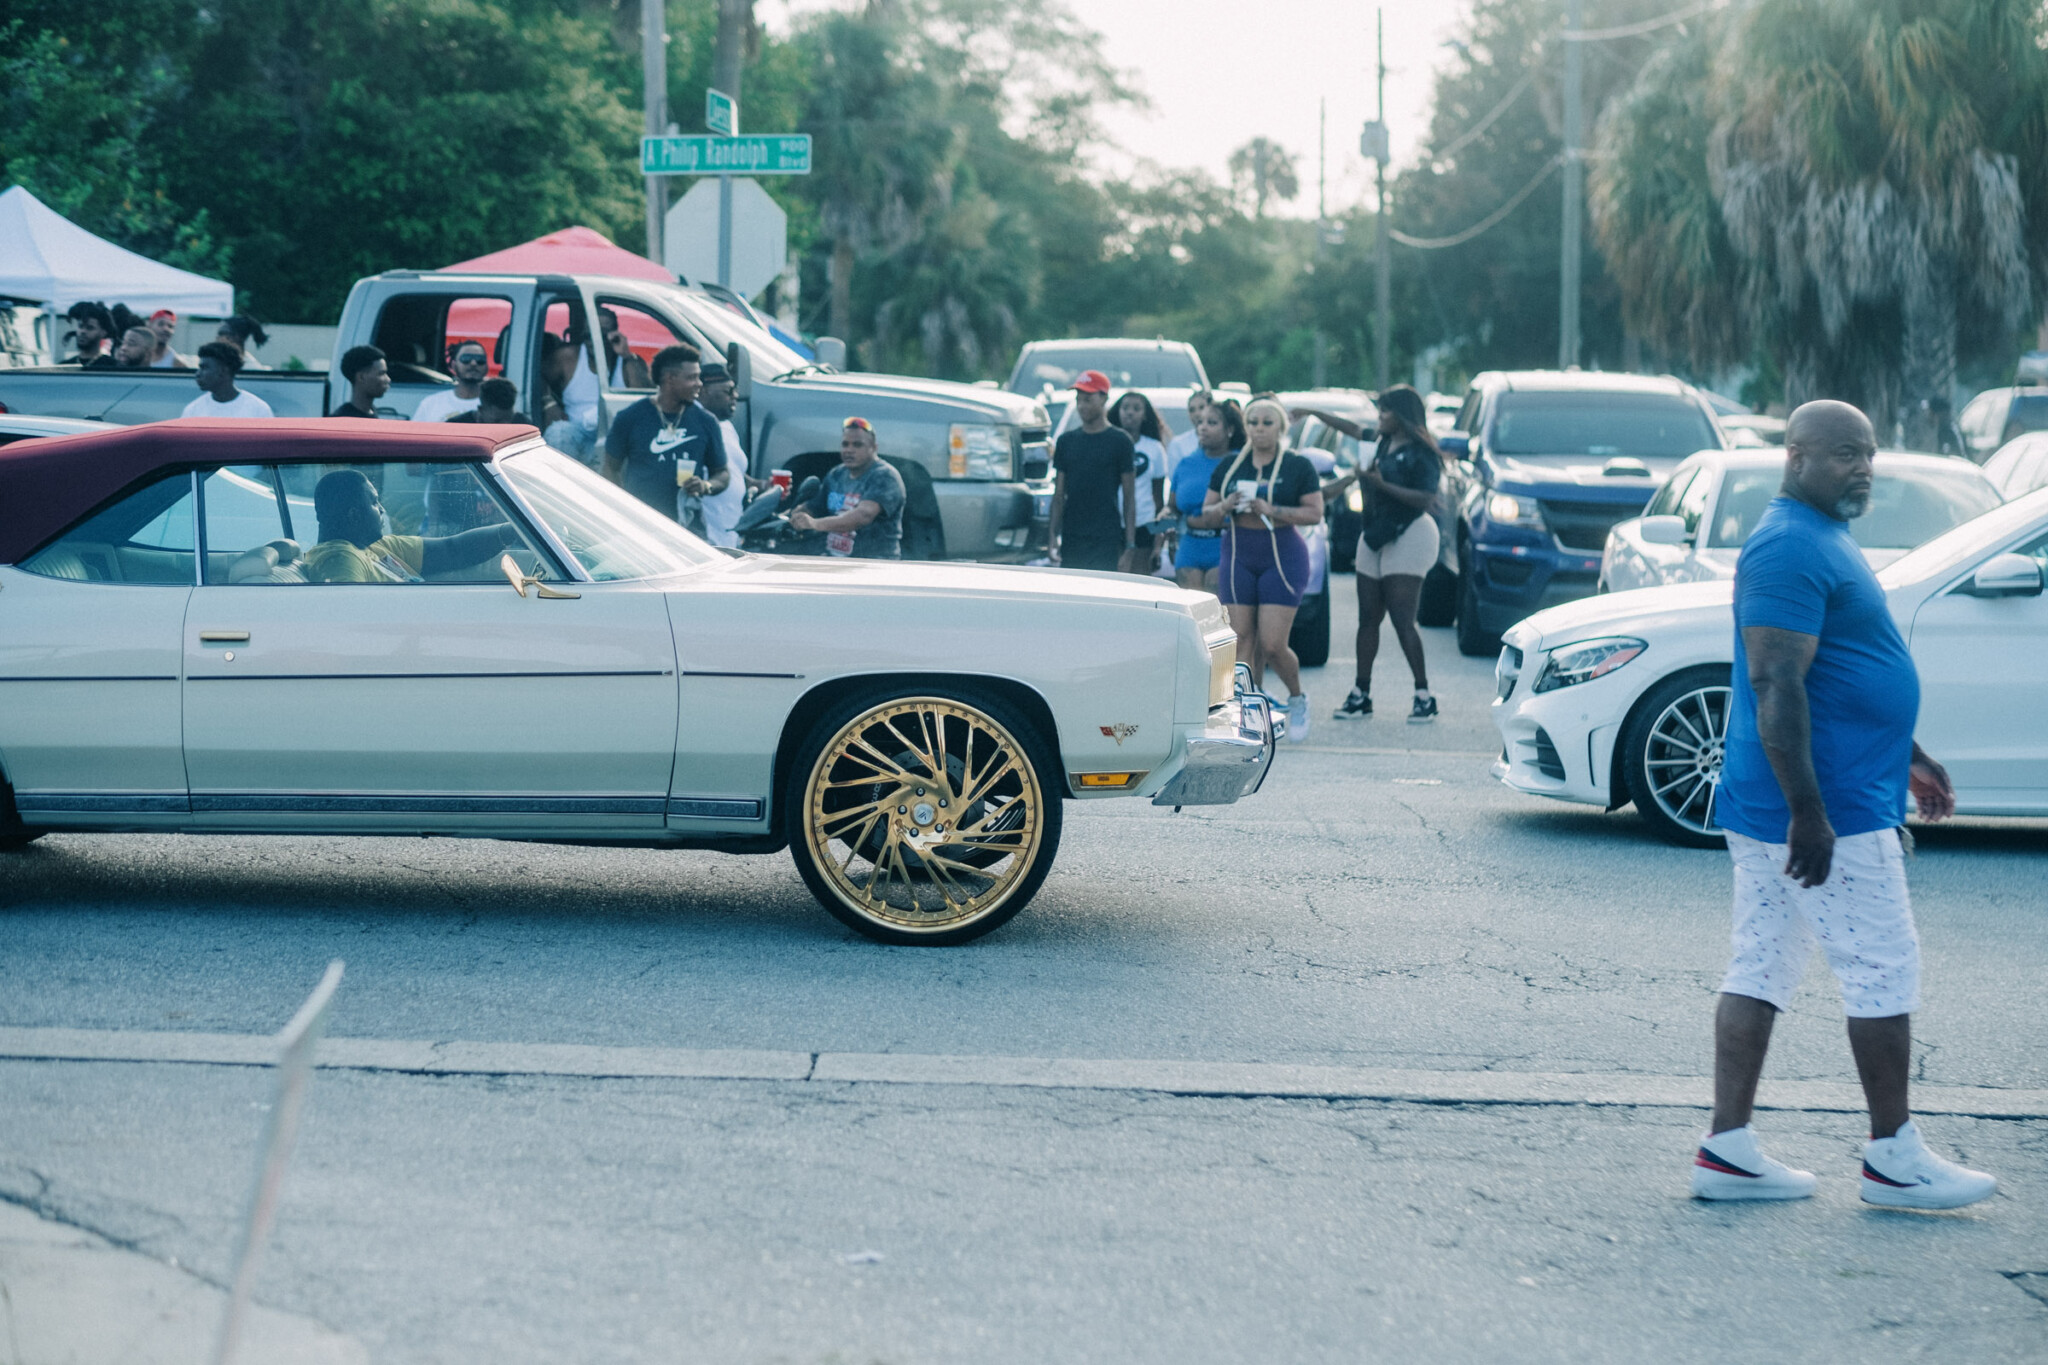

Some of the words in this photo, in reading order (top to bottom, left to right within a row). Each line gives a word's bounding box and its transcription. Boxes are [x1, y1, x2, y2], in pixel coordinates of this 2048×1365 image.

[646, 140, 655, 166] A
[662, 139, 699, 170] Philip
[706, 138, 768, 170] Randolph
[656, 428, 687, 443] NIKE
[658, 452, 690, 462] AIR
